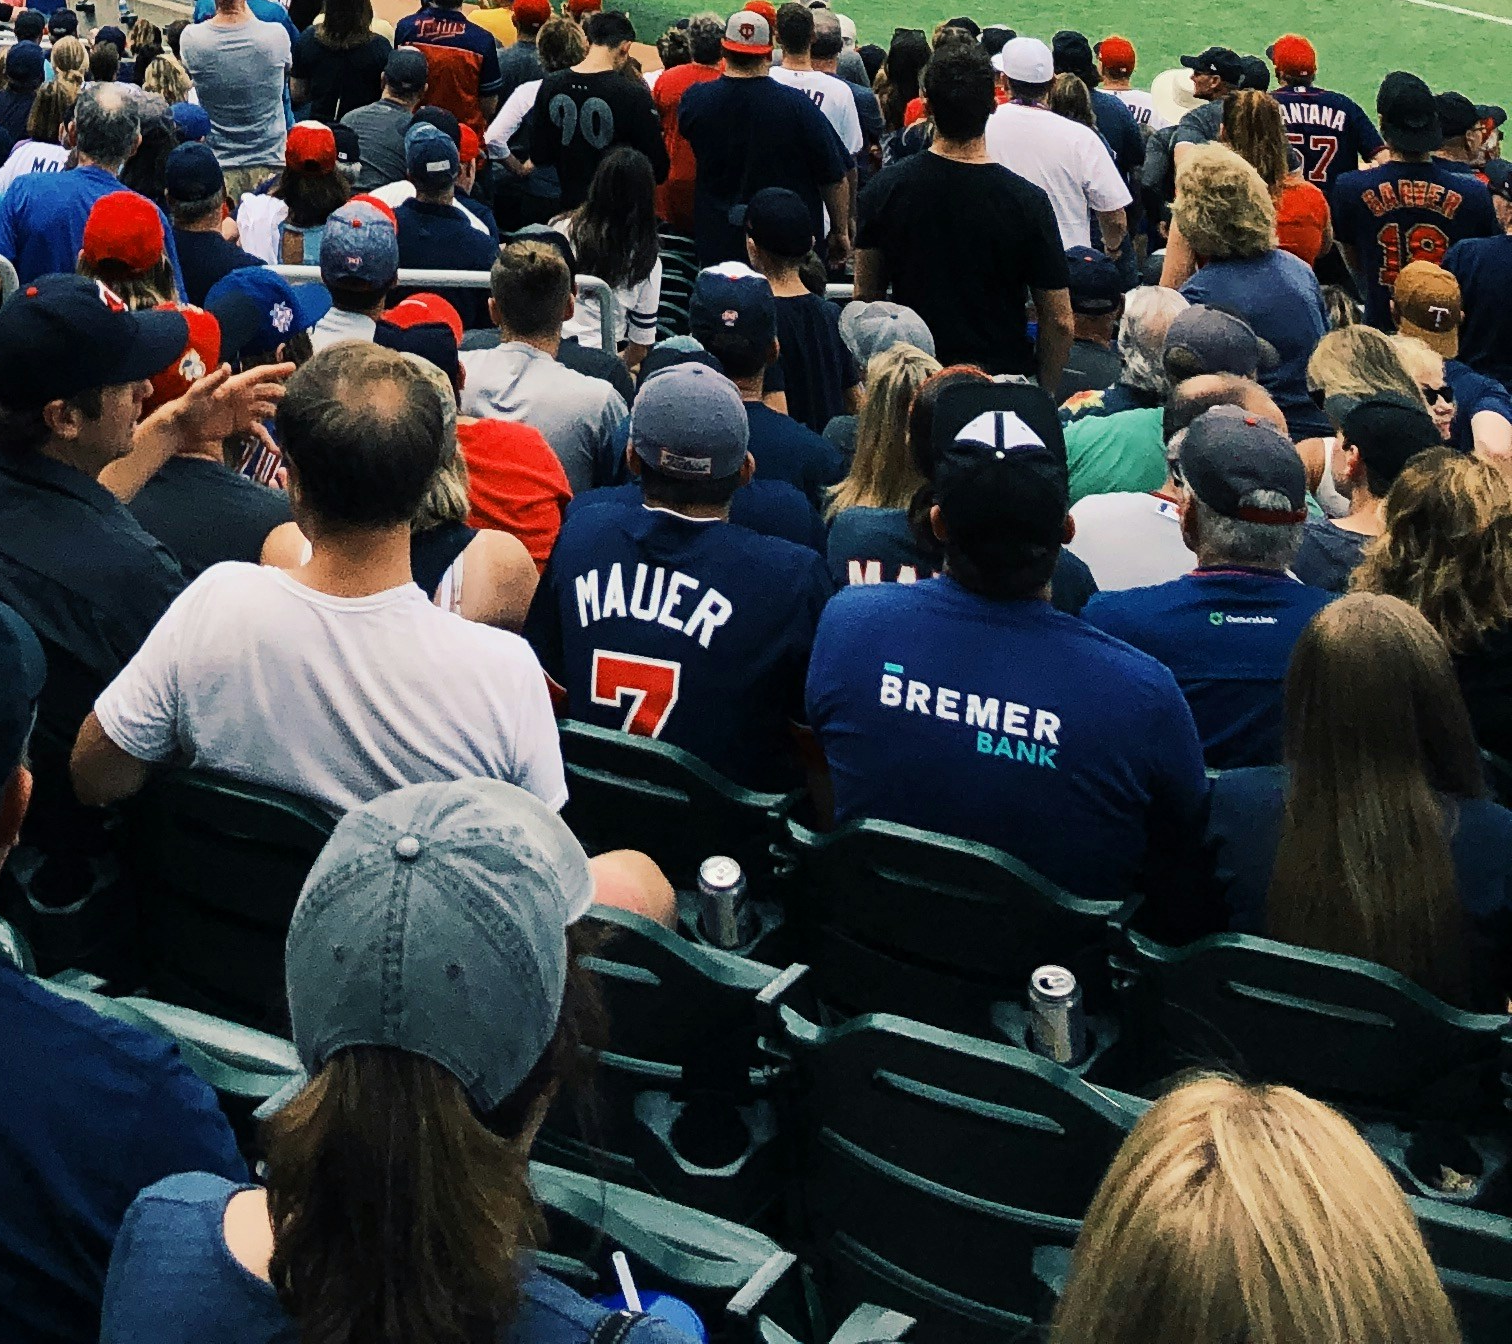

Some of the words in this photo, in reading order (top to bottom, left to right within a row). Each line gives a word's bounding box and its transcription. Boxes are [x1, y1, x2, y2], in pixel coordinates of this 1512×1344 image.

[548, 92, 615, 150] 90
[574, 561, 734, 650] MAUER
[590, 647, 682, 740] 7
[879, 672, 1062, 746] BREMER
[976, 729, 1060, 771] BANK
